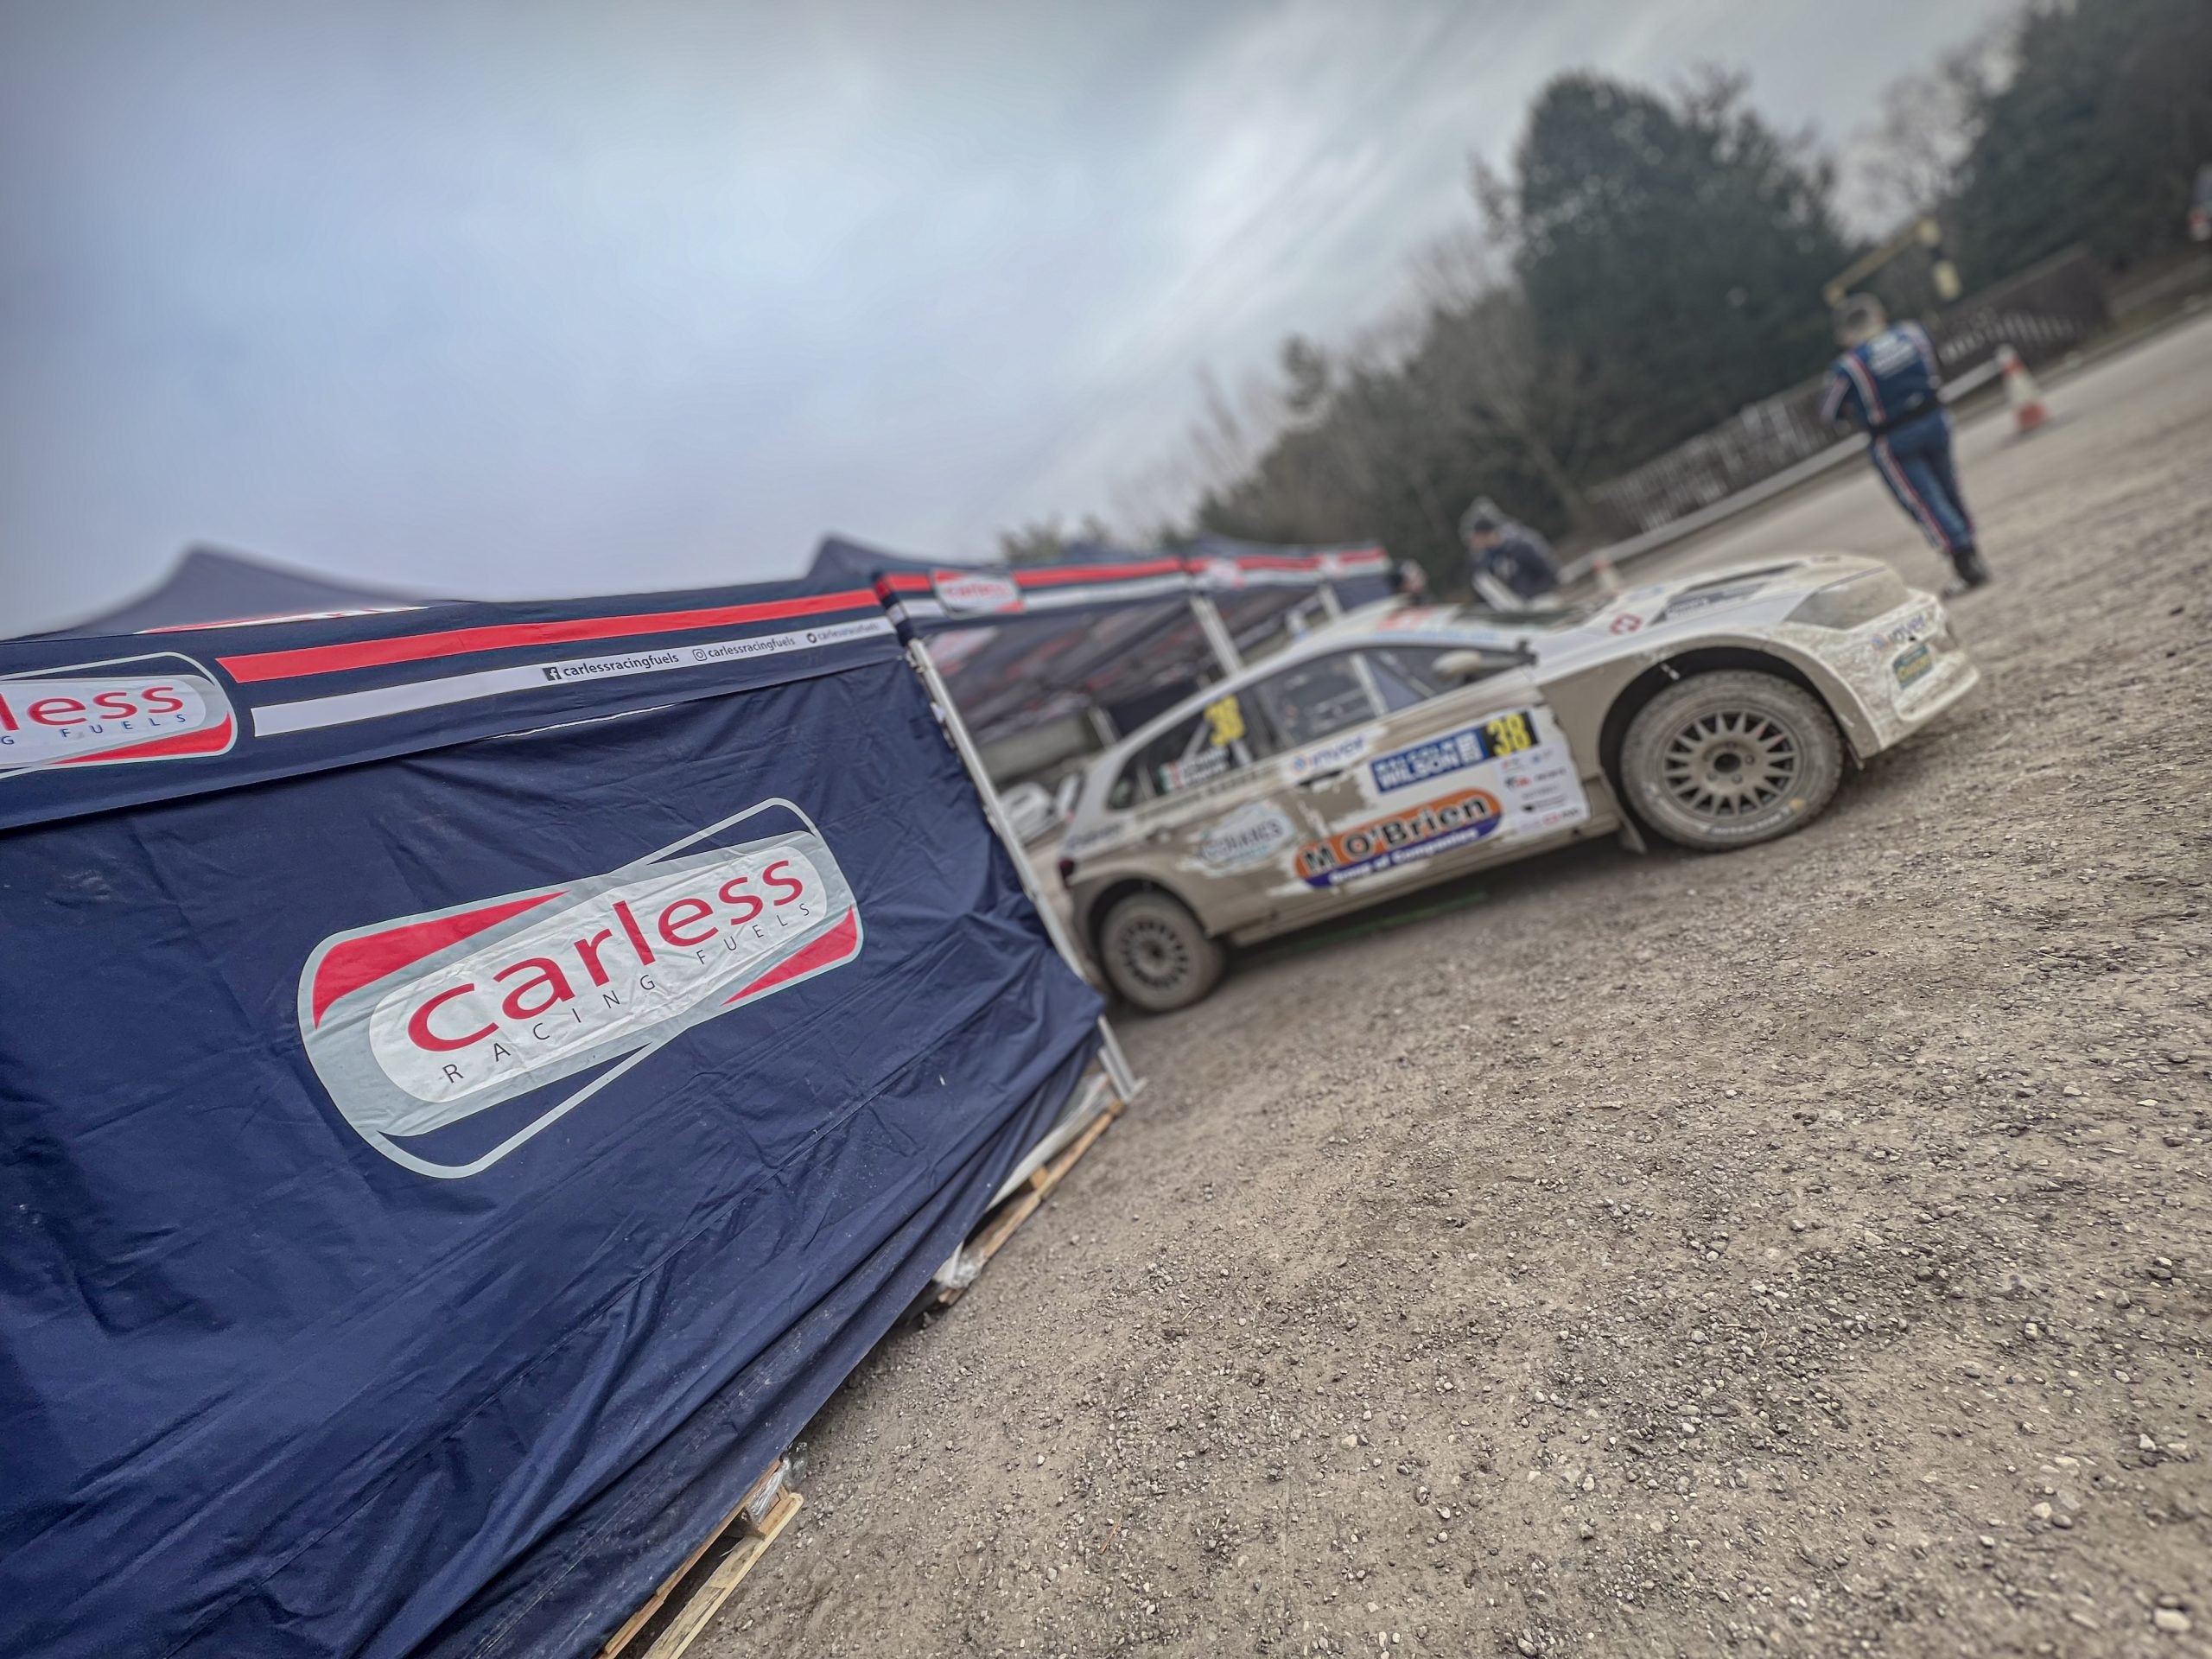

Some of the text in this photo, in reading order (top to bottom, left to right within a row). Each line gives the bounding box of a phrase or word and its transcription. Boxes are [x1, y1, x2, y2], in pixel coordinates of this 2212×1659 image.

[563, 652, 679, 677] carlessracingfuels
[709, 637, 796, 658] carlessracingfuels
[60, 714, 186, 738] FUELS
[1487, 712, 1532, 757] 38
[1378, 753, 1460, 789] WILSON
[1303, 796, 1489, 872] M O'Brien
[408, 860, 804, 1052] carless
[442, 903, 811, 1085] RACING FUELS
